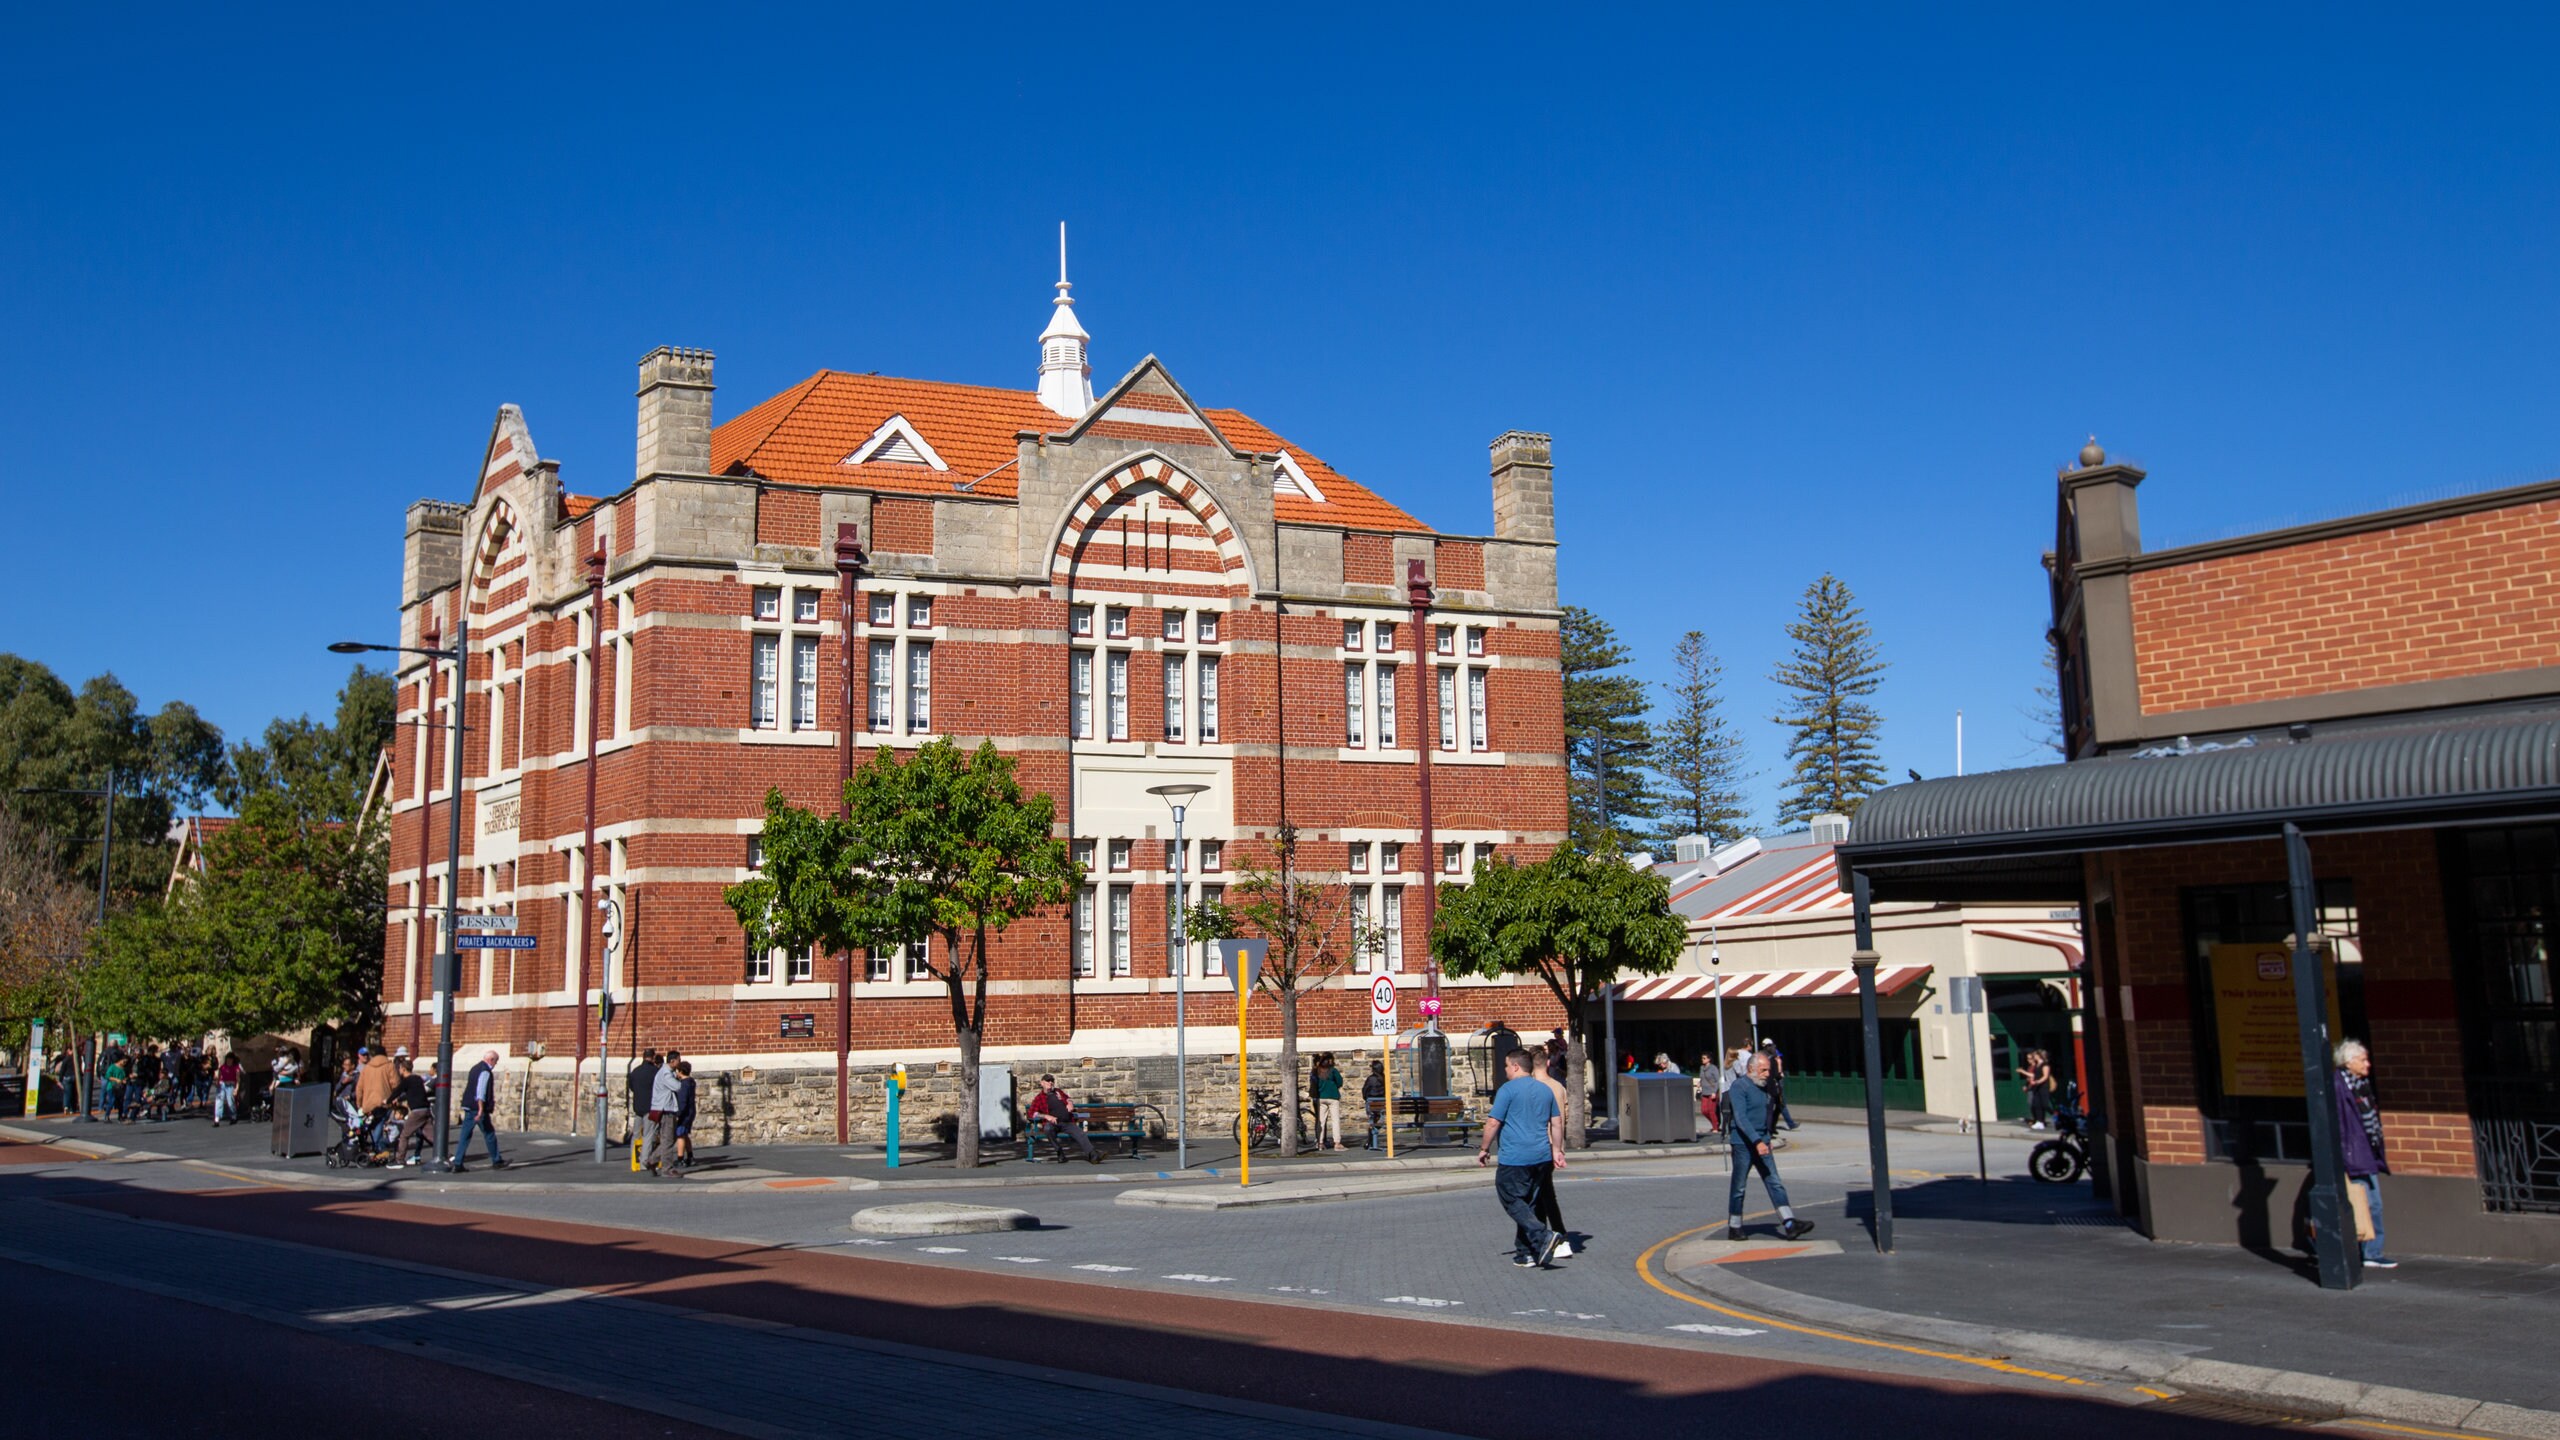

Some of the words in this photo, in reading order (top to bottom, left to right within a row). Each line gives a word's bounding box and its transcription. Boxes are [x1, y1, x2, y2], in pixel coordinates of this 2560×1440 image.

[466, 916, 506, 928] ESSEX
[458, 936, 484, 947] PIRATES
[486, 936, 529, 947] BACKPACKERS
[1376, 987, 1392, 1004] 40
[2222, 989, 2244, 998] This
[1374, 1018, 1396, 1030] AREA
